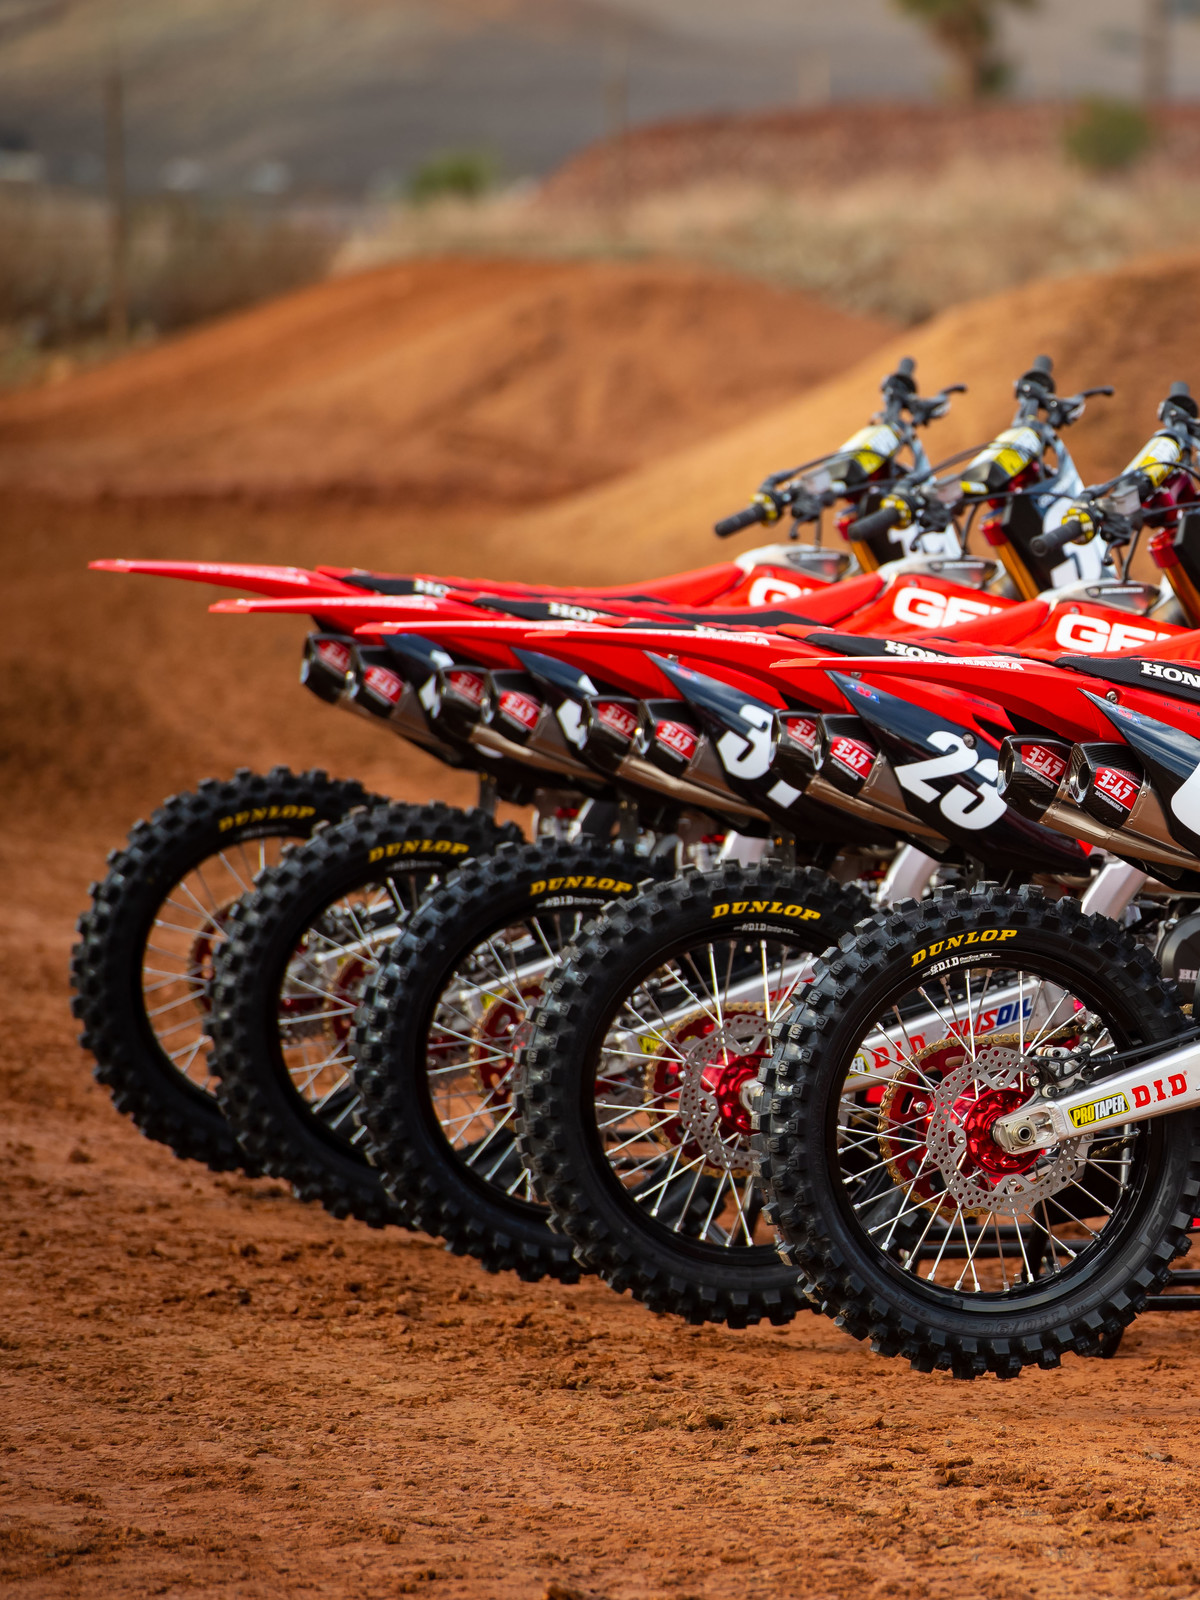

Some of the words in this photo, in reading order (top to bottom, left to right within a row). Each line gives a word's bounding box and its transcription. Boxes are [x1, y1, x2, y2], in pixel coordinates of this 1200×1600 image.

[894, 731, 1007, 830] 23
[368, 840, 470, 863] DUNLOP
[530, 876, 633, 896] DUNLOP
[711, 901, 822, 920] DUNLOP
[911, 930, 1018, 968] DUNLOP
[1131, 1072, 1188, 1108] D.I.D
[1071, 1095, 1129, 1126] PROTAPER
